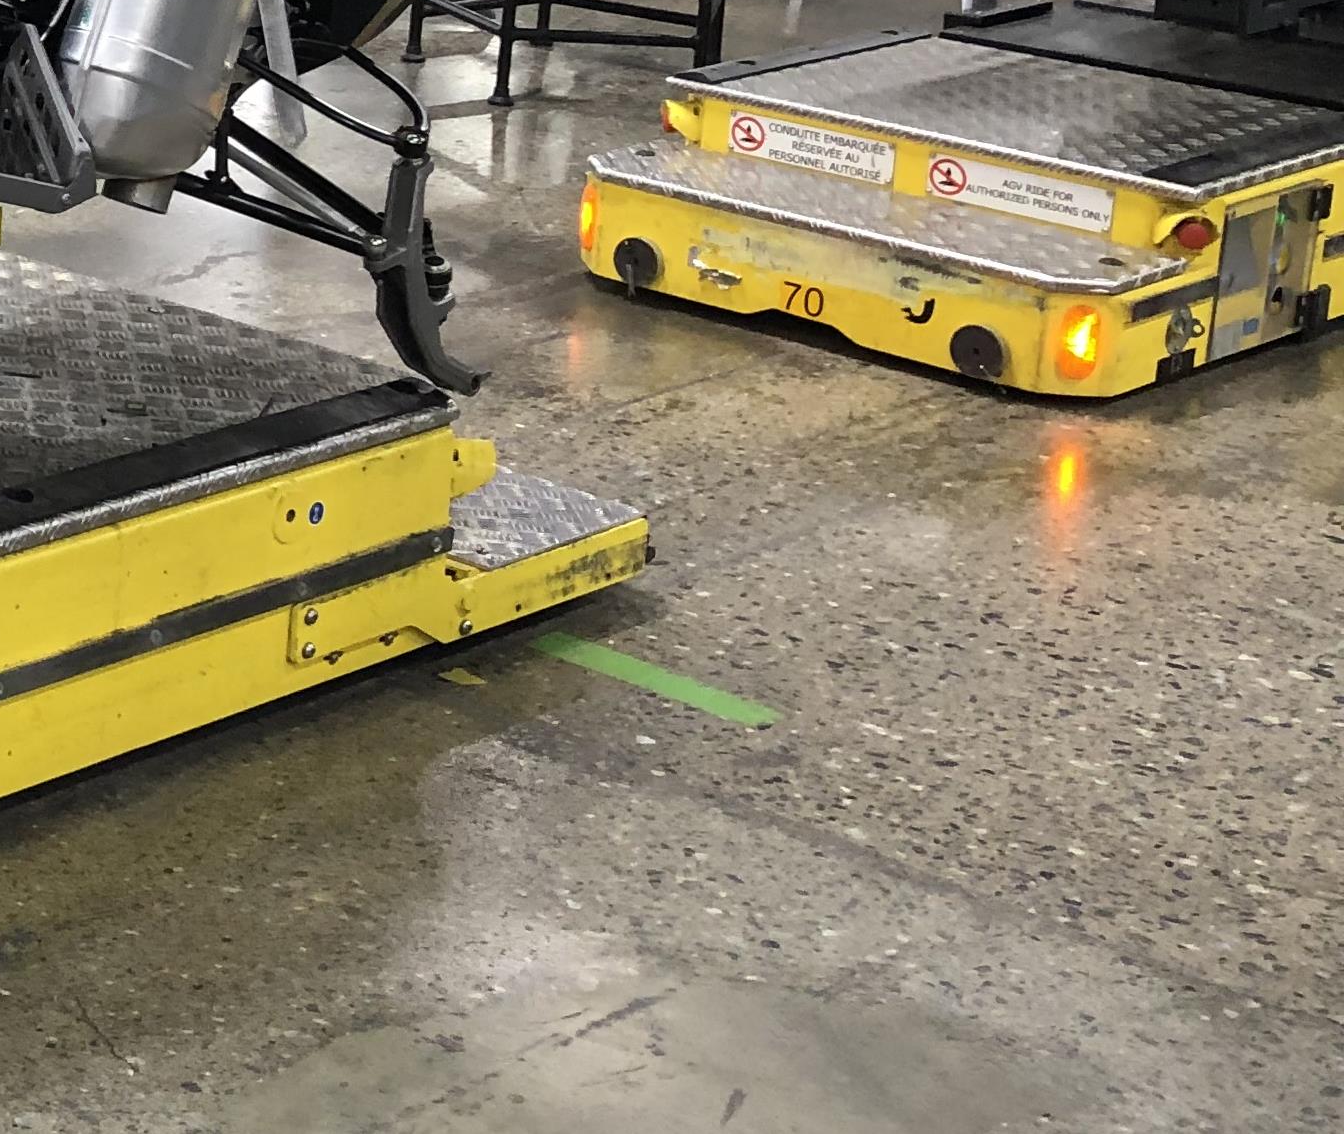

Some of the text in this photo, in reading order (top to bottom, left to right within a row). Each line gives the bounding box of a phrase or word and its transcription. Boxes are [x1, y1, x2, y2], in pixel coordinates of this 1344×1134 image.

[768, 122, 887, 156] CONDUITE EMBARQUÉE
[791, 139, 860, 164] RÉSERVÉE AU
[768, 149, 881, 182] PERSONNEL AUTORISÉ
[966, 183, 1109, 223] AUTHORIZED PERSONS ONLY
[1002, 179, 1074, 203] AGV RIDE FOR
[783, 281, 824, 318] 70
